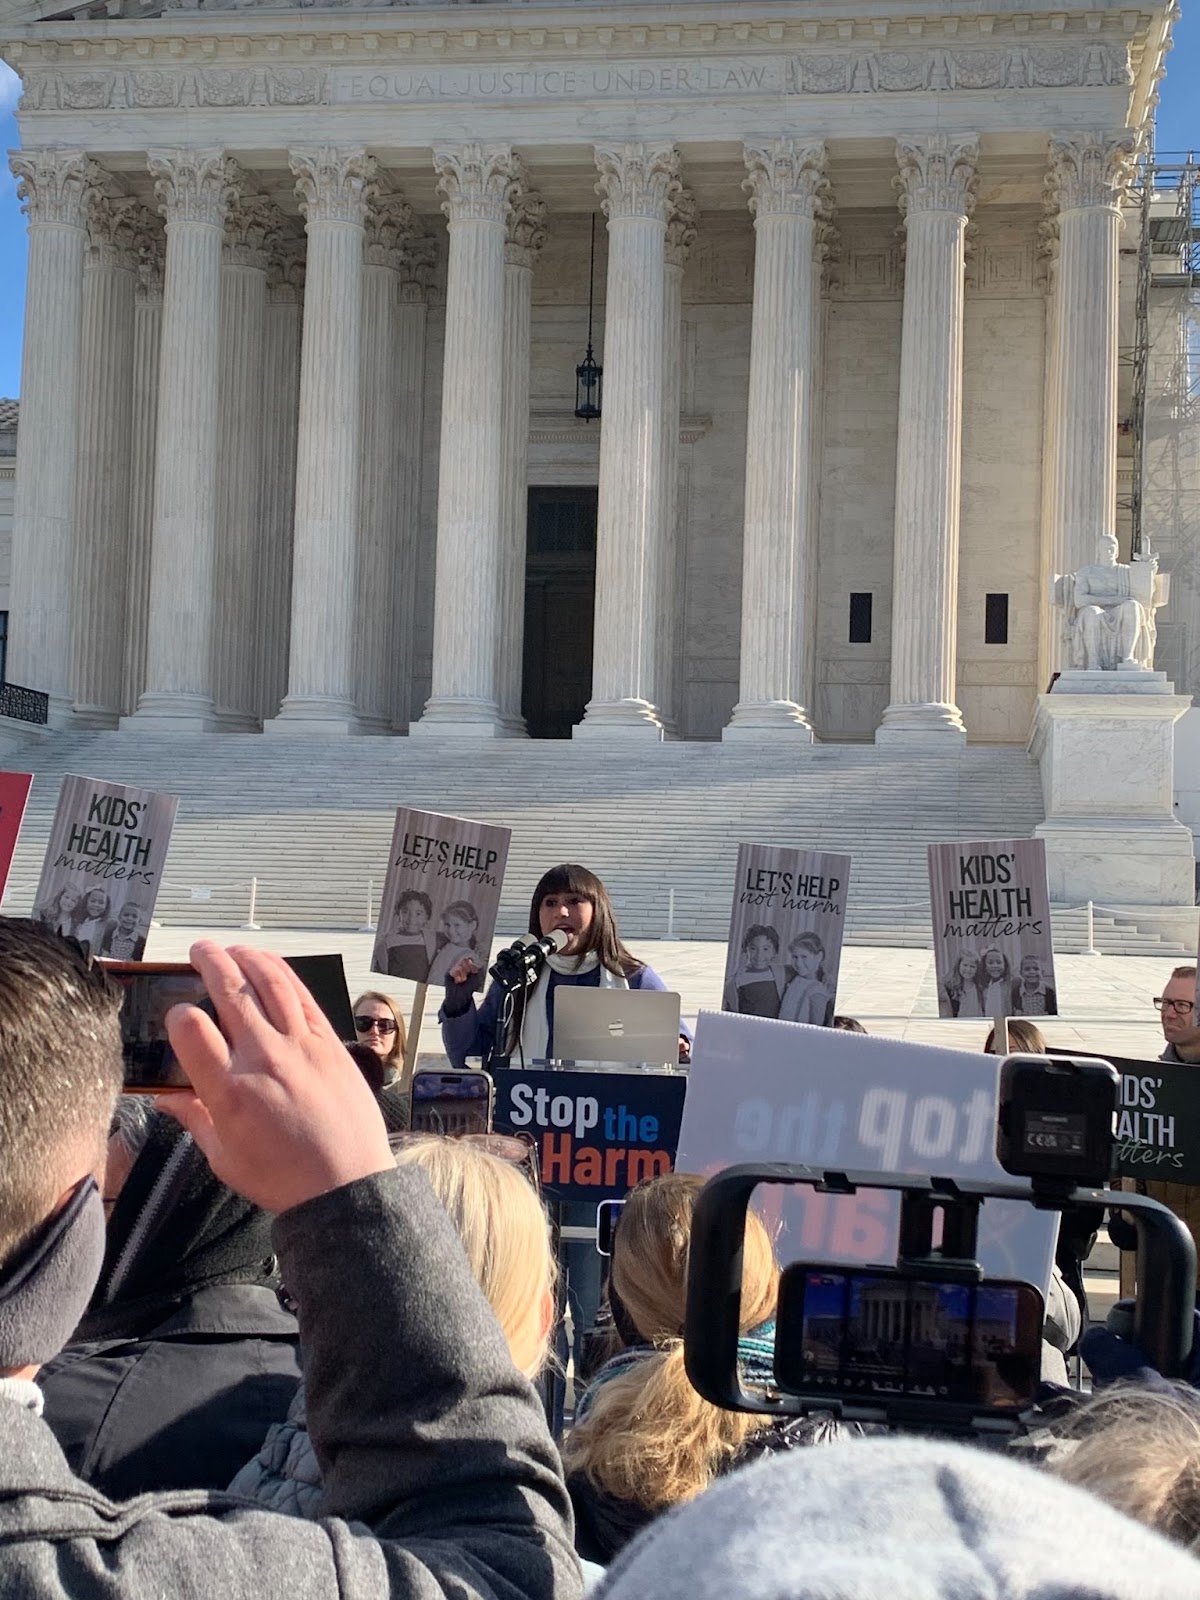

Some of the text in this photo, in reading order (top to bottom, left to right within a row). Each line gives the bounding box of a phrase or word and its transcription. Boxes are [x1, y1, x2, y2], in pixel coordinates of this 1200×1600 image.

[351, 66, 766, 98] EQUAL JUSTICE UNDER LAW
[87, 793, 147, 830] KIDS'
[67, 823, 152, 866] HEALTH
[402, 833, 497, 871] LET'S HELP
[54, 852, 156, 885] matters
[395, 854, 497, 887] not harm
[746, 868, 840, 899] LET'S HELP
[959, 854, 1015, 885] KIDS'
[740, 887, 841, 915] not harm
[949, 887, 1032, 920] HEALTH
[943, 913, 1043, 938] matters
[509, 1083, 659, 1143] Stop the
[1117, 1110, 1175, 1148] ALTH
[541, 1132, 671, 1187] Harm
[1116, 1137, 1184, 1168] tters
